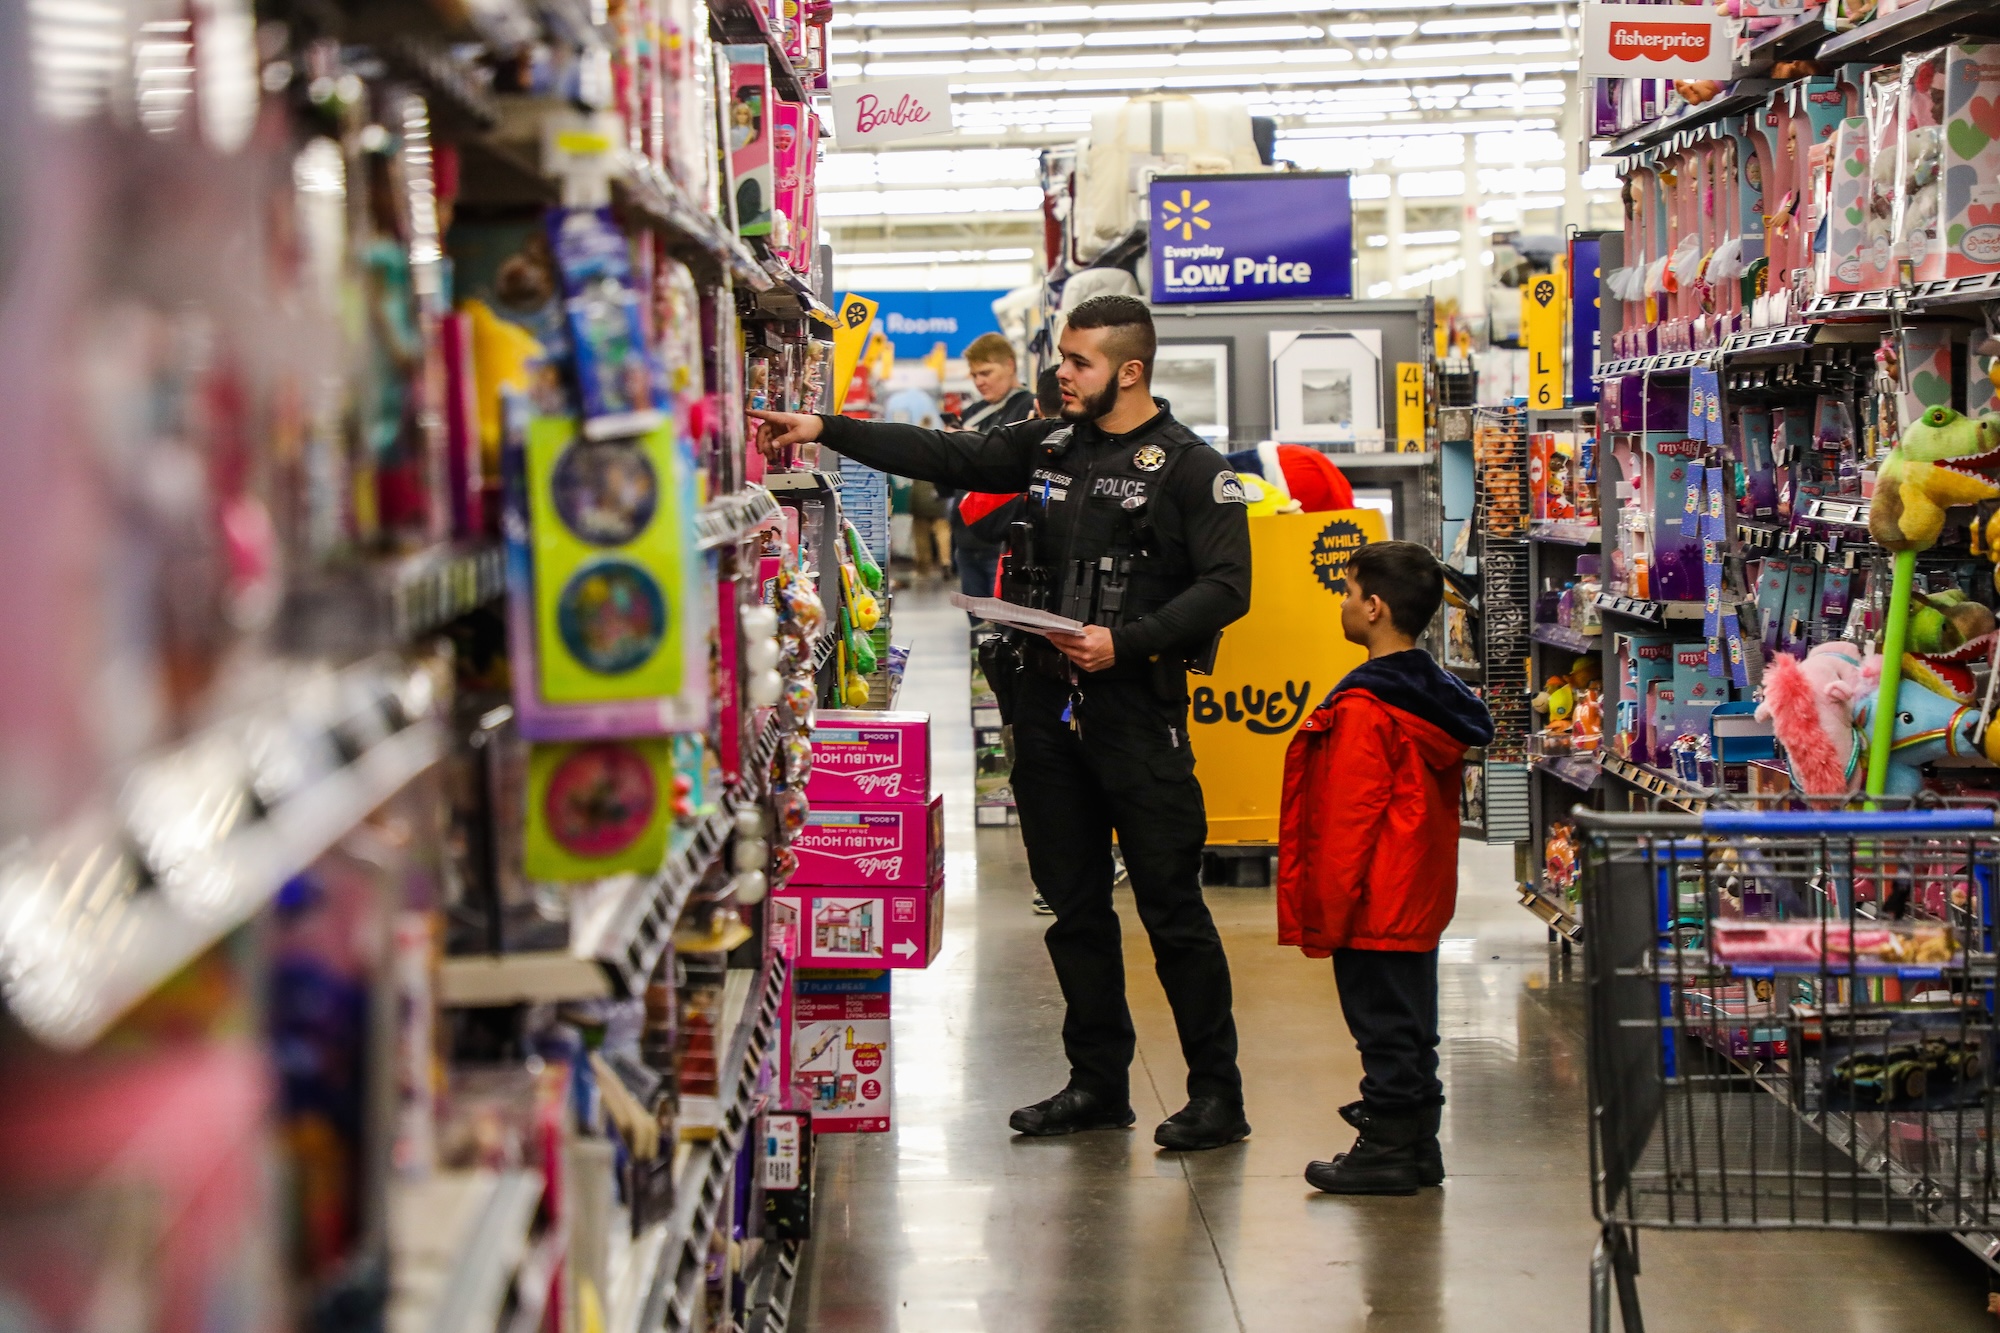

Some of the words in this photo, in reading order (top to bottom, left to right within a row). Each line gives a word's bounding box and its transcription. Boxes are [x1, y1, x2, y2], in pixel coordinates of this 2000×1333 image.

[1614, 28, 1705, 51] fisher-price
[856, 93, 931, 133] Barbie
[1163, 244, 1225, 260] Everyday
[1164, 259, 1230, 286] Low
[1233, 255, 1312, 285] Price
[887, 312, 958, 335] Rooms
[1537, 351, 1550, 375] L
[1404, 390, 1419, 406] H
[1538, 383, 1550, 404] 6
[1093, 478, 1146, 497] POLICE
[1323, 533, 1361, 549] WHILE
[1328, 568, 1347, 581] LA
[1194, 680, 1311, 735] BLUEY
[811, 752, 841, 764] HOU
[844, 753, 894, 764] MALIBU
[853, 772, 902, 798] Barbie
[796, 835, 842, 847] HOUSE
[845, 836, 895, 847] MALIBU
[854, 856, 903, 881] Barbie
[802, 982, 809, 992] 7
[811, 982, 833, 991] PLAY
[835, 982, 867, 991] AREAS!
[855, 1059, 880, 1067] SLIDE!
[868, 1081, 875, 1090] 2
